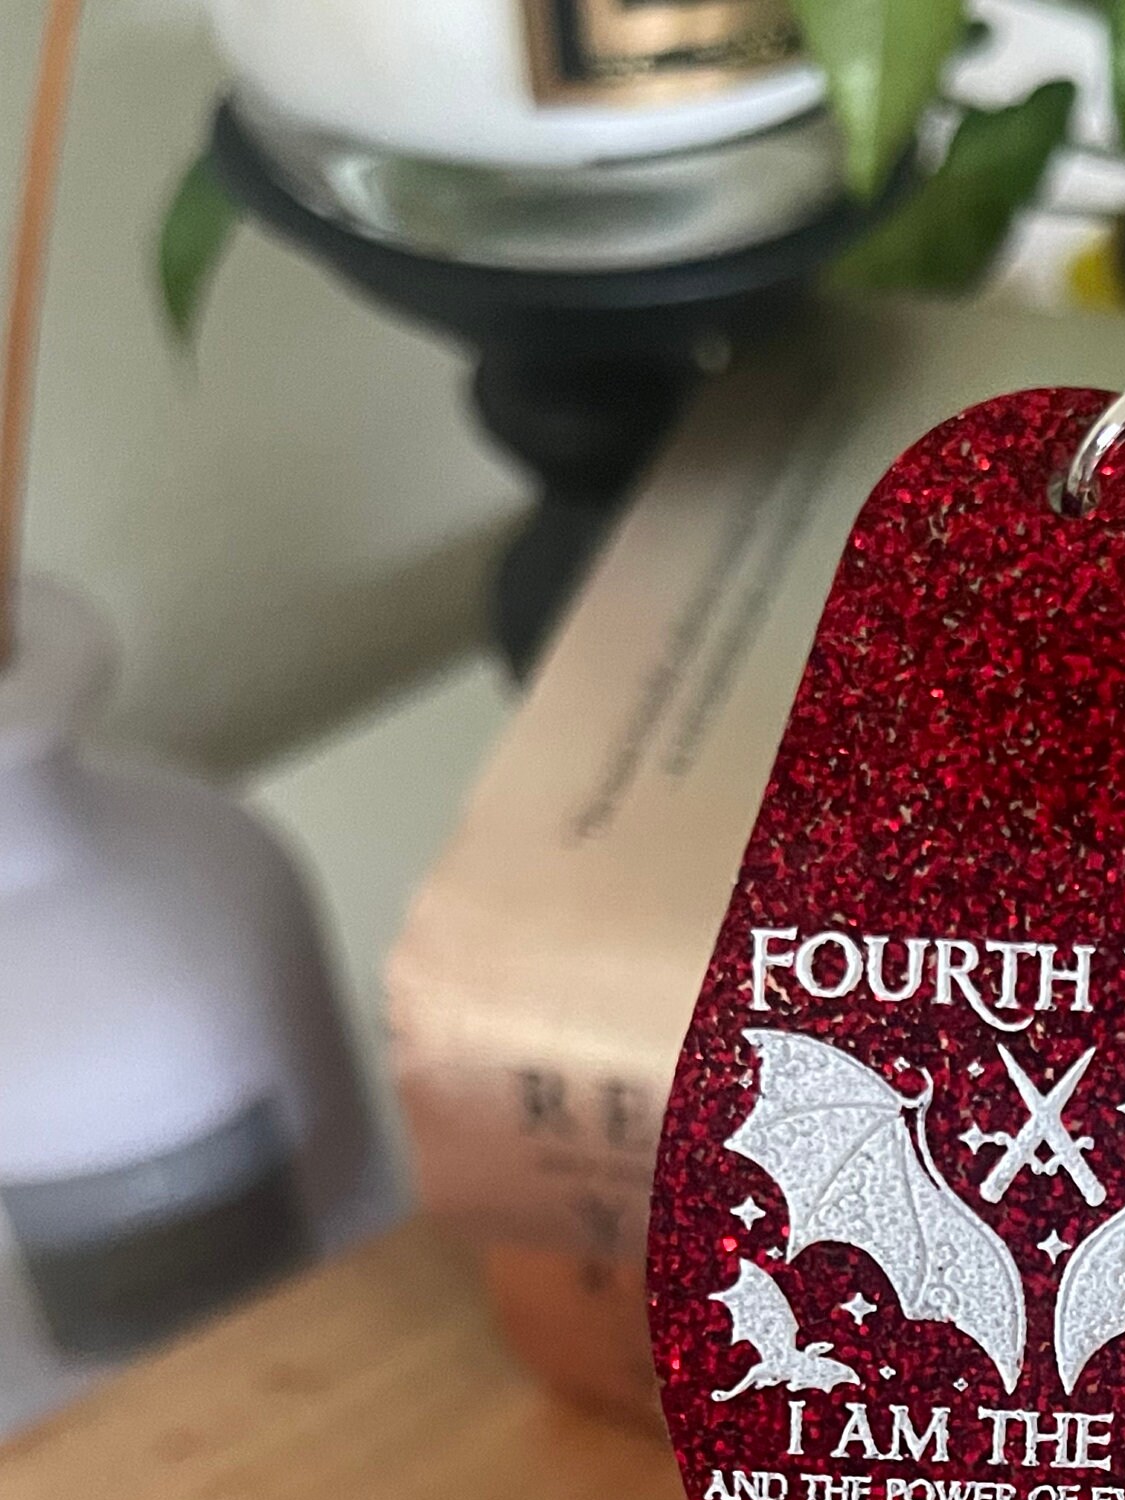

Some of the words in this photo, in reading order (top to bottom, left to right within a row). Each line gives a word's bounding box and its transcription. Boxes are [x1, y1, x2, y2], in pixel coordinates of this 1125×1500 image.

[749, 926, 1097, 1033] FOURTH
[786, 1400, 807, 1455] I
[829, 1402, 952, 1463] AM
[977, 1405, 1115, 1472] THE
